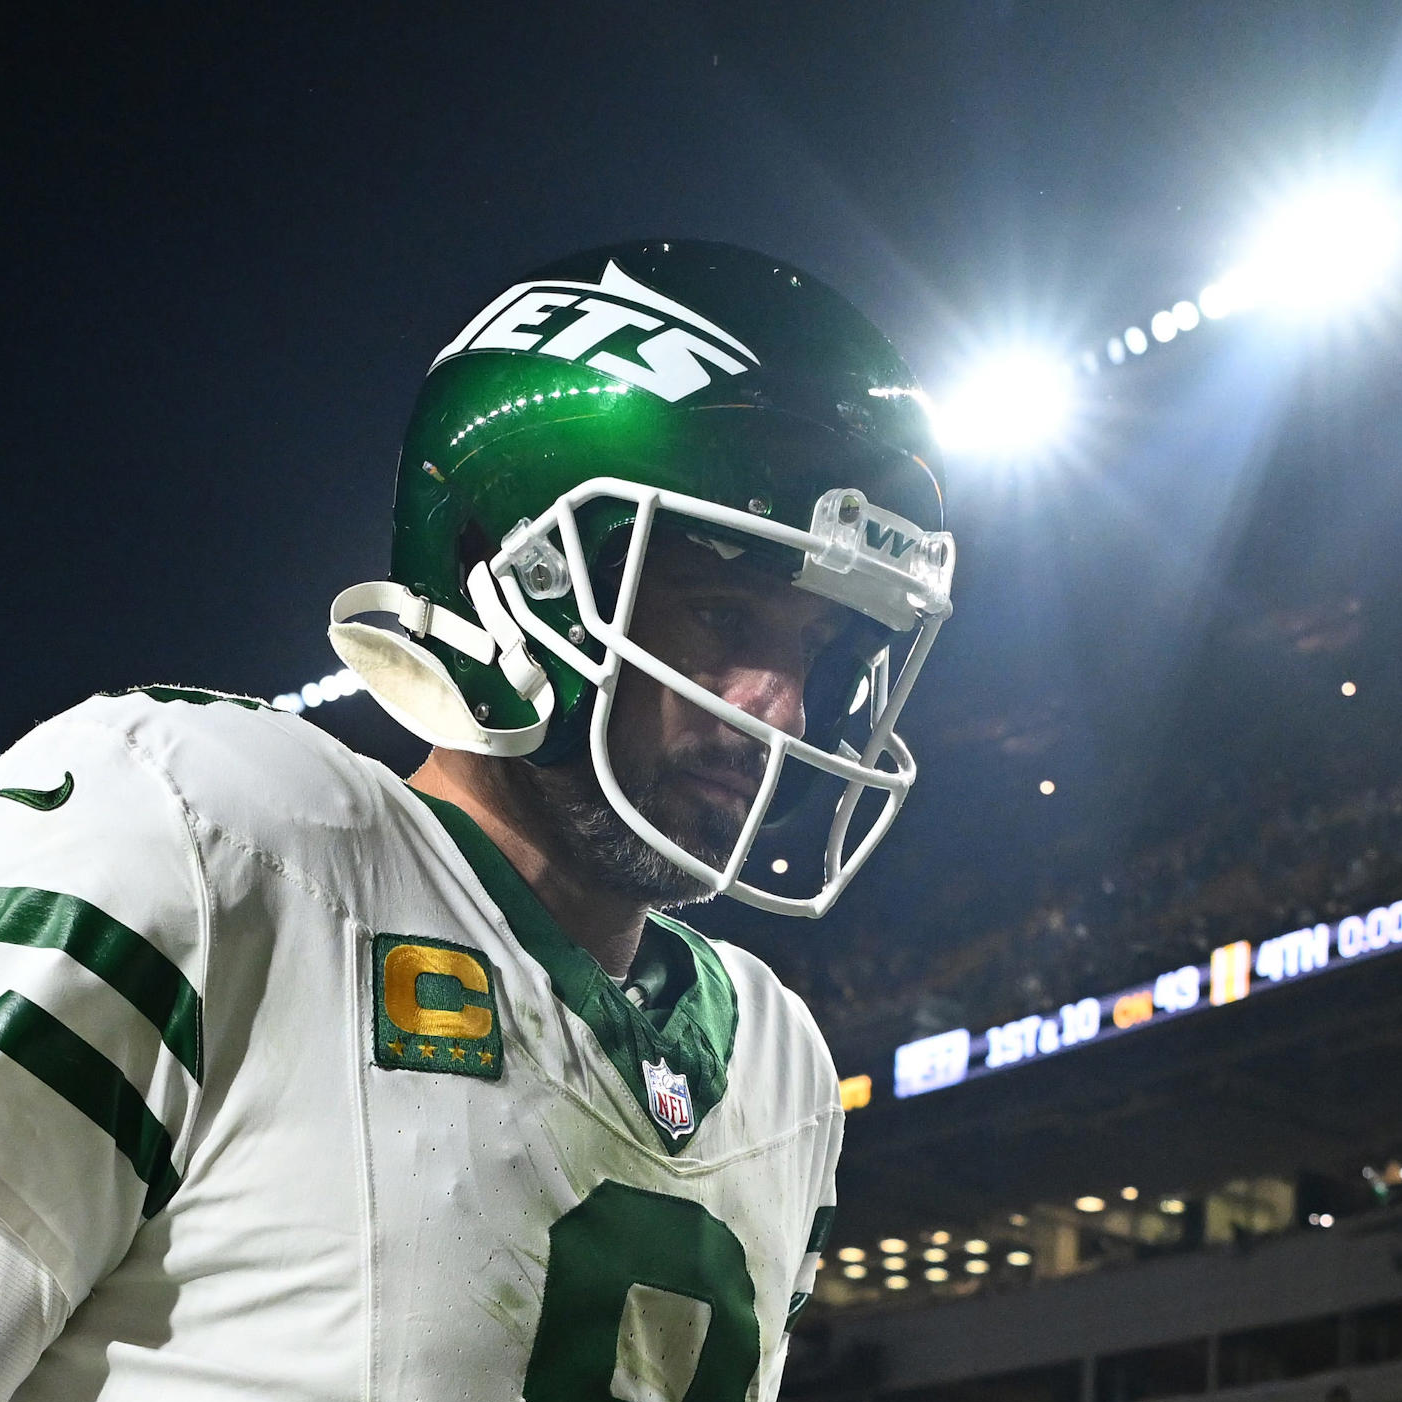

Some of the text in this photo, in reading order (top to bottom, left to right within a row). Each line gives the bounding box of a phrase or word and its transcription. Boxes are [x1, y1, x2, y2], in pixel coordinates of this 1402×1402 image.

[426, 258, 761, 403] JETS
[1256, 922, 1331, 982] 4TH
[383, 943, 494, 1040] C
[655, 1089, 689, 1125] NFL
